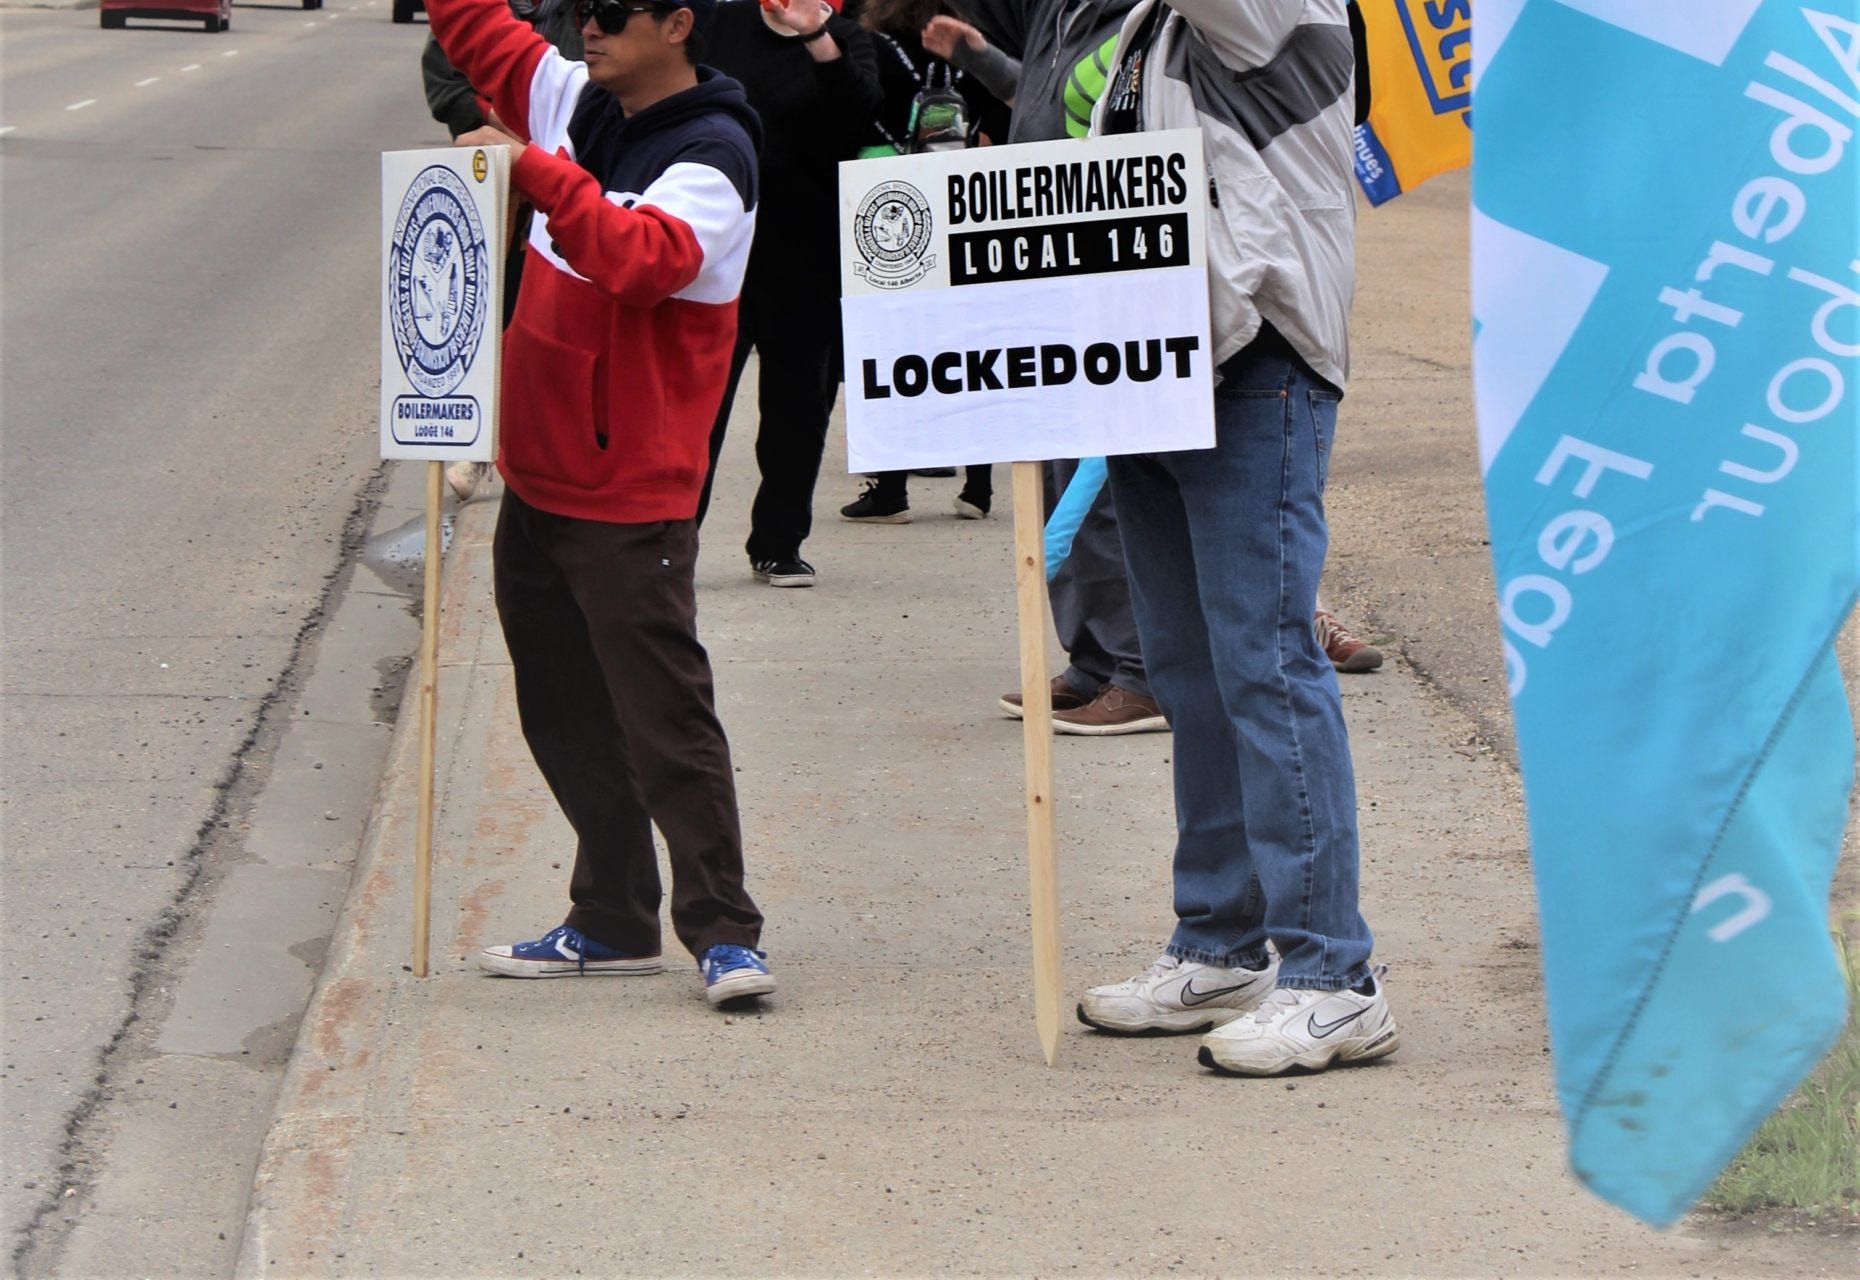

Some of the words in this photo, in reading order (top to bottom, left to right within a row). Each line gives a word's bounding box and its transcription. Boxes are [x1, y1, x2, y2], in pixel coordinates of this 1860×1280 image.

[947, 152, 1187, 225] BOILERMAKERS
[964, 233, 1081, 275] LOCAL
[1108, 223, 1174, 263] 146
[862, 335, 1200, 400] LOCKEDOUT
[398, 403, 474, 420] BOILERMAKERS
[415, 425, 438, 437] LODGE
[441, 425, 453, 437] 146
